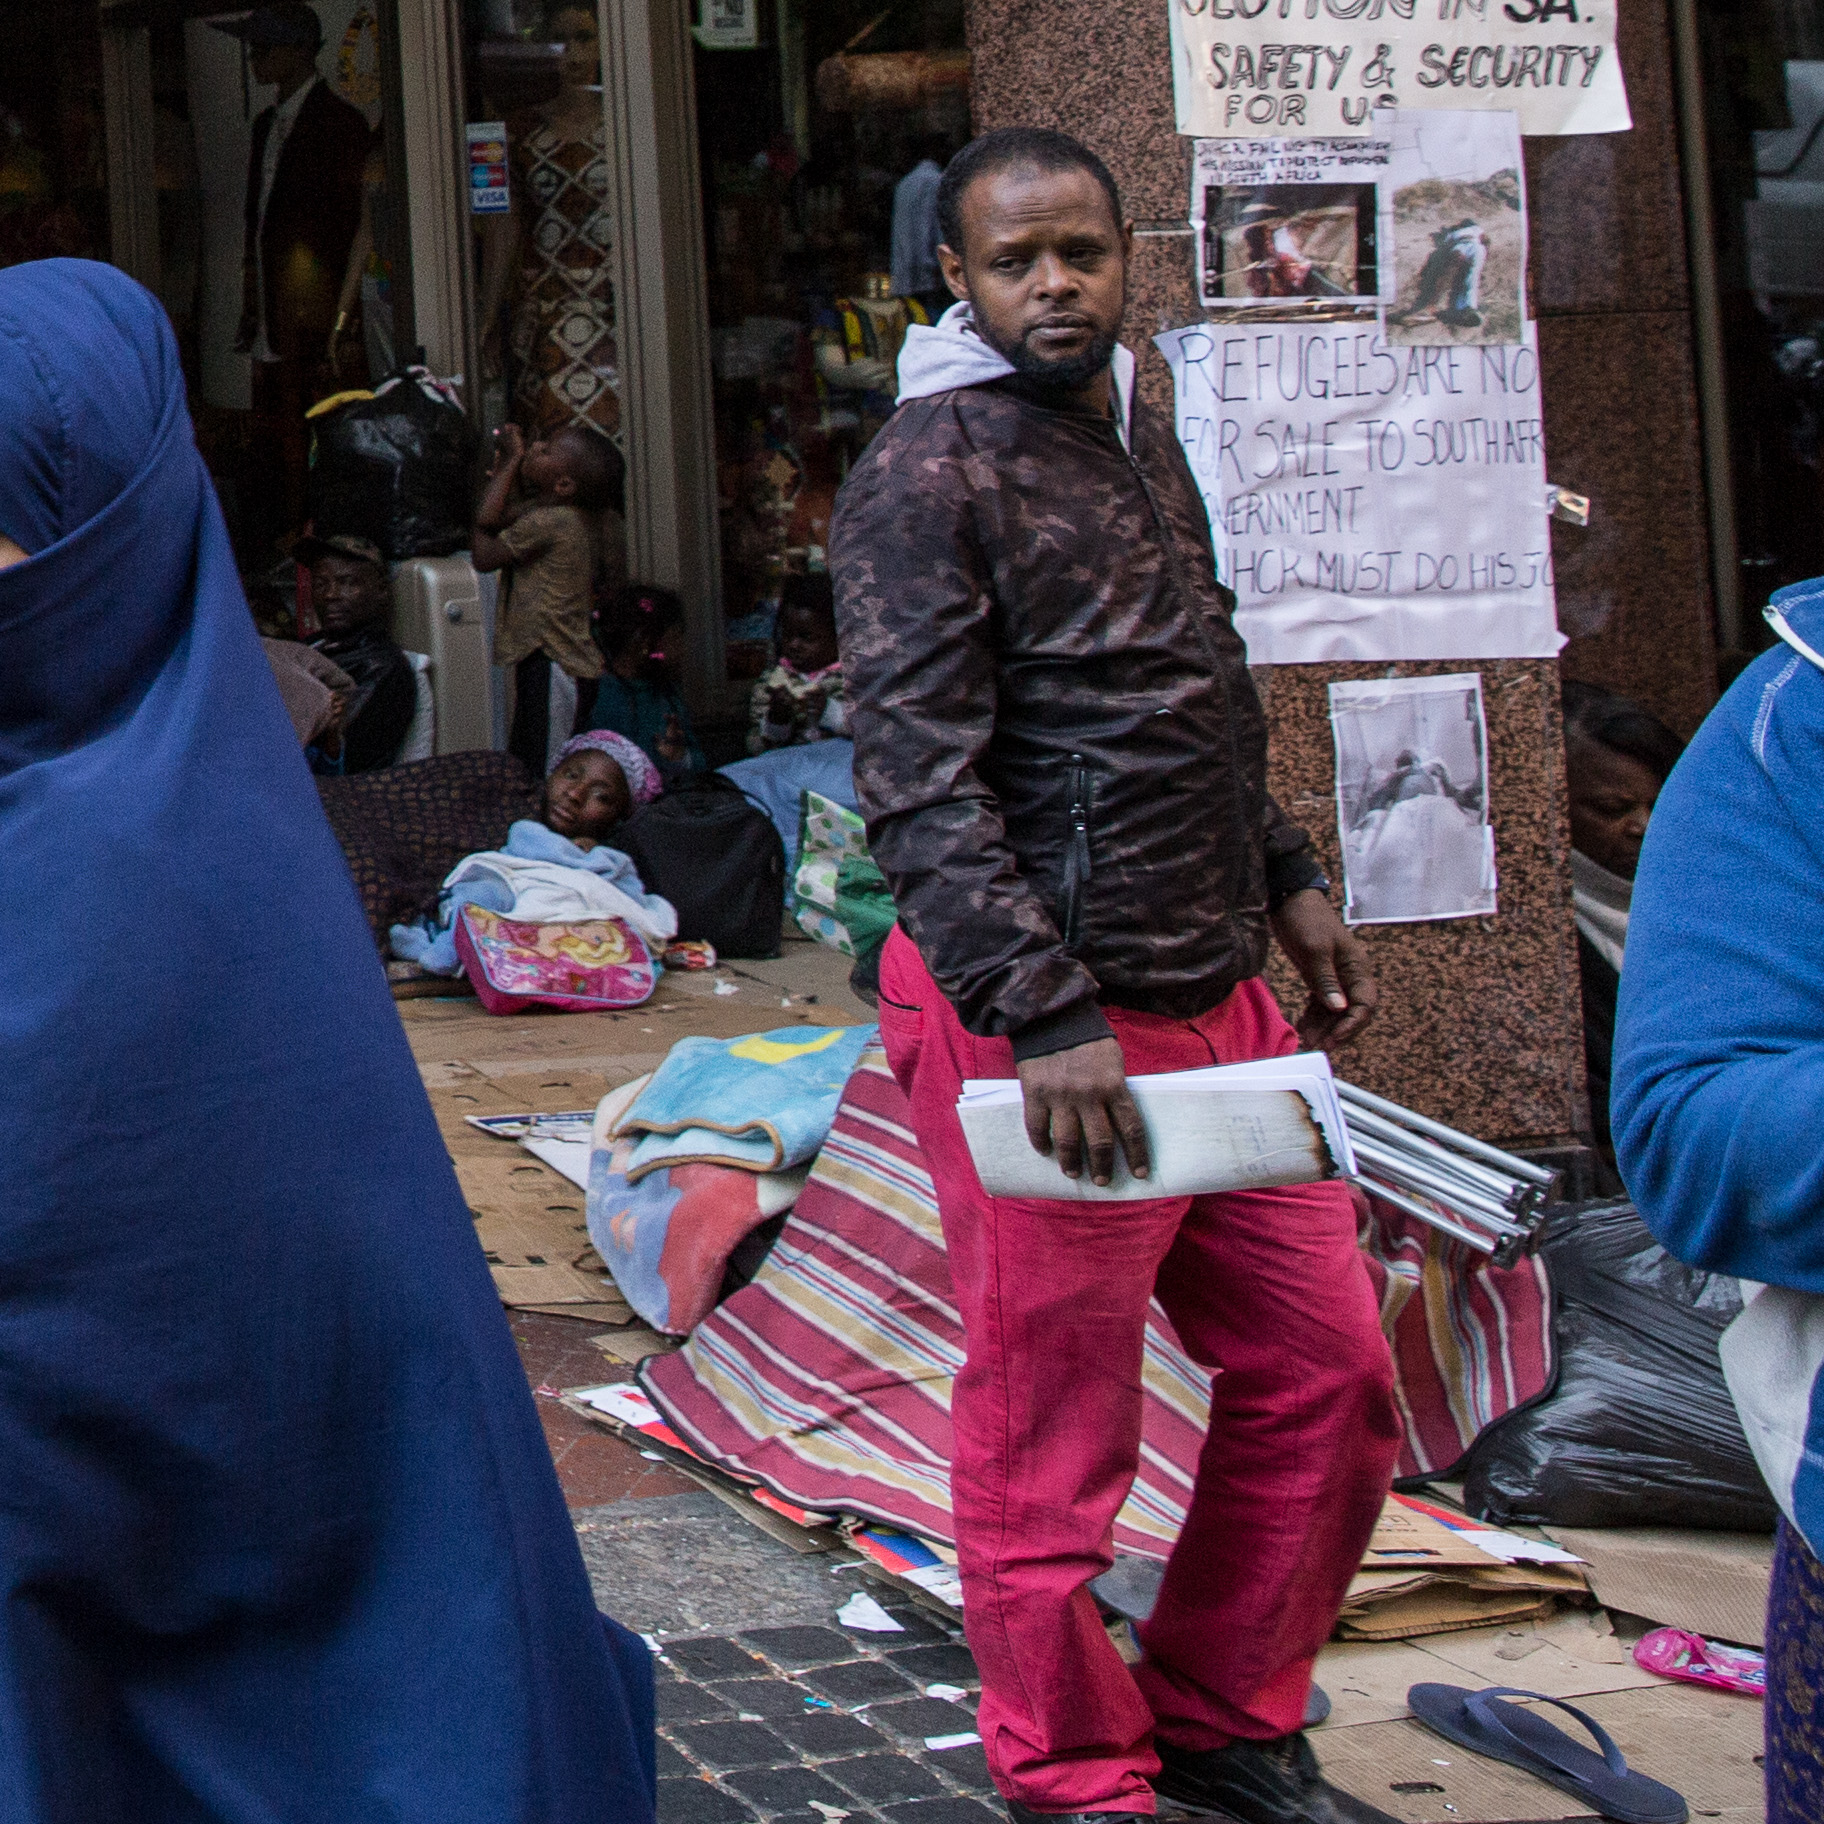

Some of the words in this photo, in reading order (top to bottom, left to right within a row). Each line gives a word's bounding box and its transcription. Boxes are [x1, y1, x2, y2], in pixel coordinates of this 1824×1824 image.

[1207, 42, 1352, 91] SAFETY
[1362, 44, 1397, 89] &
[1416, 43, 1604, 90] SECURITY
[1224, 93, 1307, 128] FOR
[1178, 332, 1399, 403] REFUGEES
[1182, 416, 1246, 483] FOR
[1253, 419, 1340, 479] SALE
[1357, 418, 1406, 473] TO
[1316, 550, 1403, 594] MUST
[1415, 552, 1460, 592] DO
[1469, 551, 1518, 588] HIS
